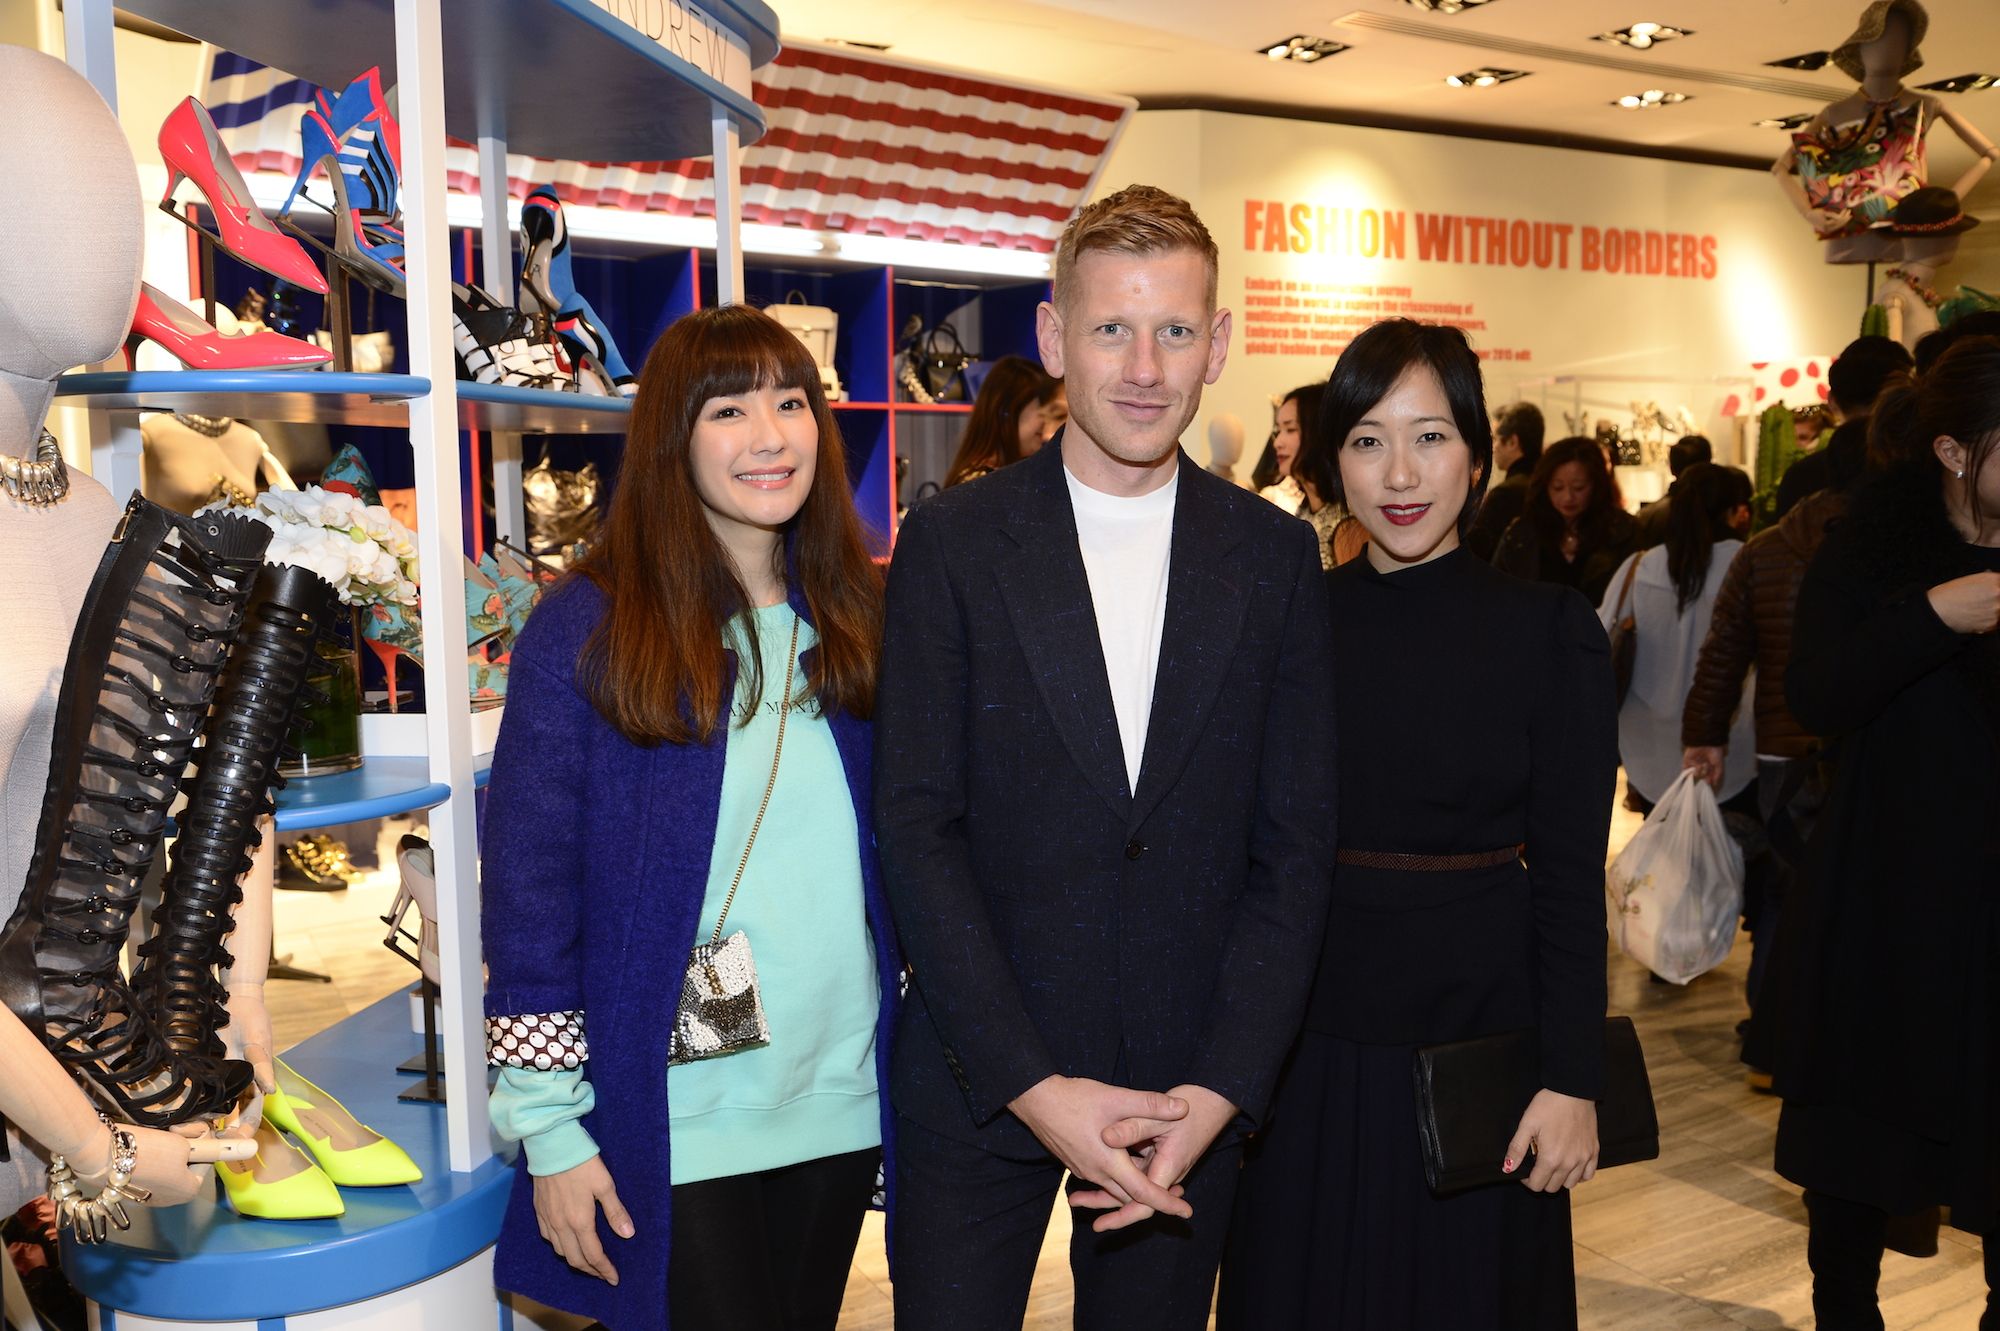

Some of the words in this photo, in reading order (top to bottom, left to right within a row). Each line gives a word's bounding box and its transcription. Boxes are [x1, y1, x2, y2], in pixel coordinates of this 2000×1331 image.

[1244, 200, 1405, 259] FASHION
[1415, 213, 1573, 269] WITHOUT
[1581, 227, 1718, 280] BORDERS
[1245, 277, 1281, 290] Embark
[1377, 287, 1411, 298] journey
[1246, 296, 1280, 307] around
[1285, 296, 1299, 307] the
[1384, 301, 1397, 312] the
[1465, 304, 1473, 314] of
[1246, 311, 1311, 323] multicultural
[1245, 325, 1288, 338] Embrace
[1292, 328, 1307, 339] the
[1246, 342, 1277, 356] global
[1280, 343, 1317, 355] fashion
[1493, 349, 1512, 361] 2015
